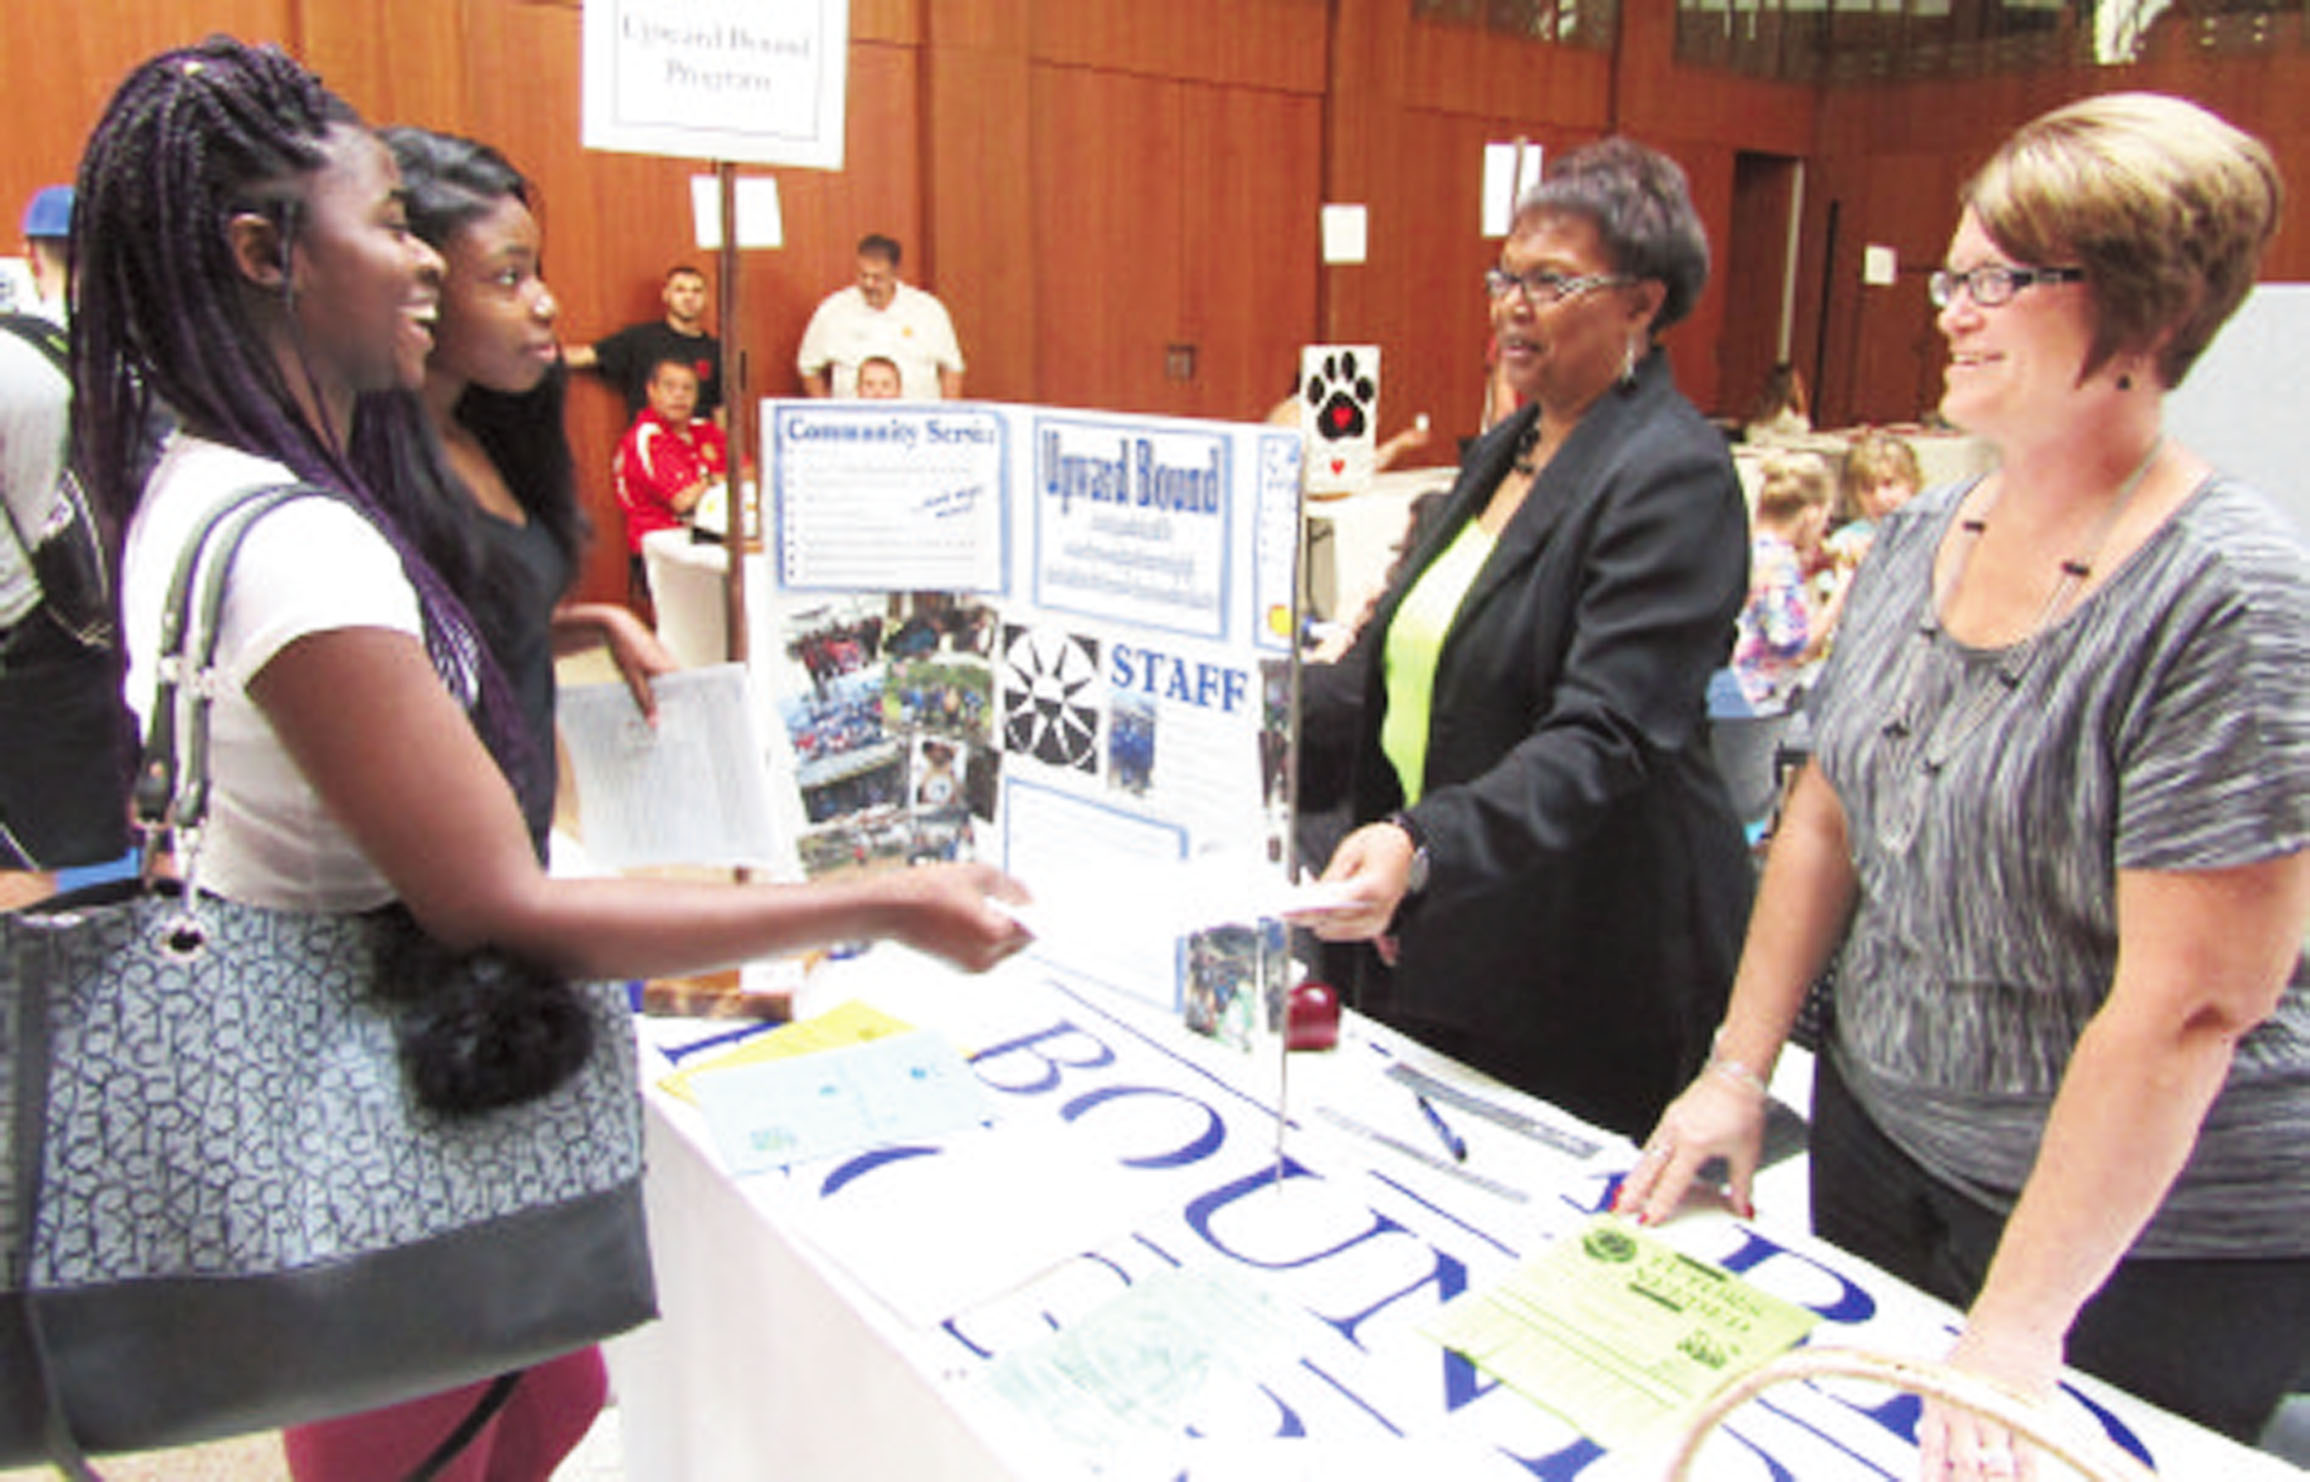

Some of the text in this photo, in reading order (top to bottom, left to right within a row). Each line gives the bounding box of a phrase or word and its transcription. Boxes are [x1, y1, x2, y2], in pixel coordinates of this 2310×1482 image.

[622, 14, 811, 60] Upward Bound
[663, 58, 773, 92] Program
[787, 417, 918, 451] Community
[1043, 429, 1129, 516] Upward
[1136, 437, 1219, 514] Bound
[1111, 643, 1249, 712] STAFF
